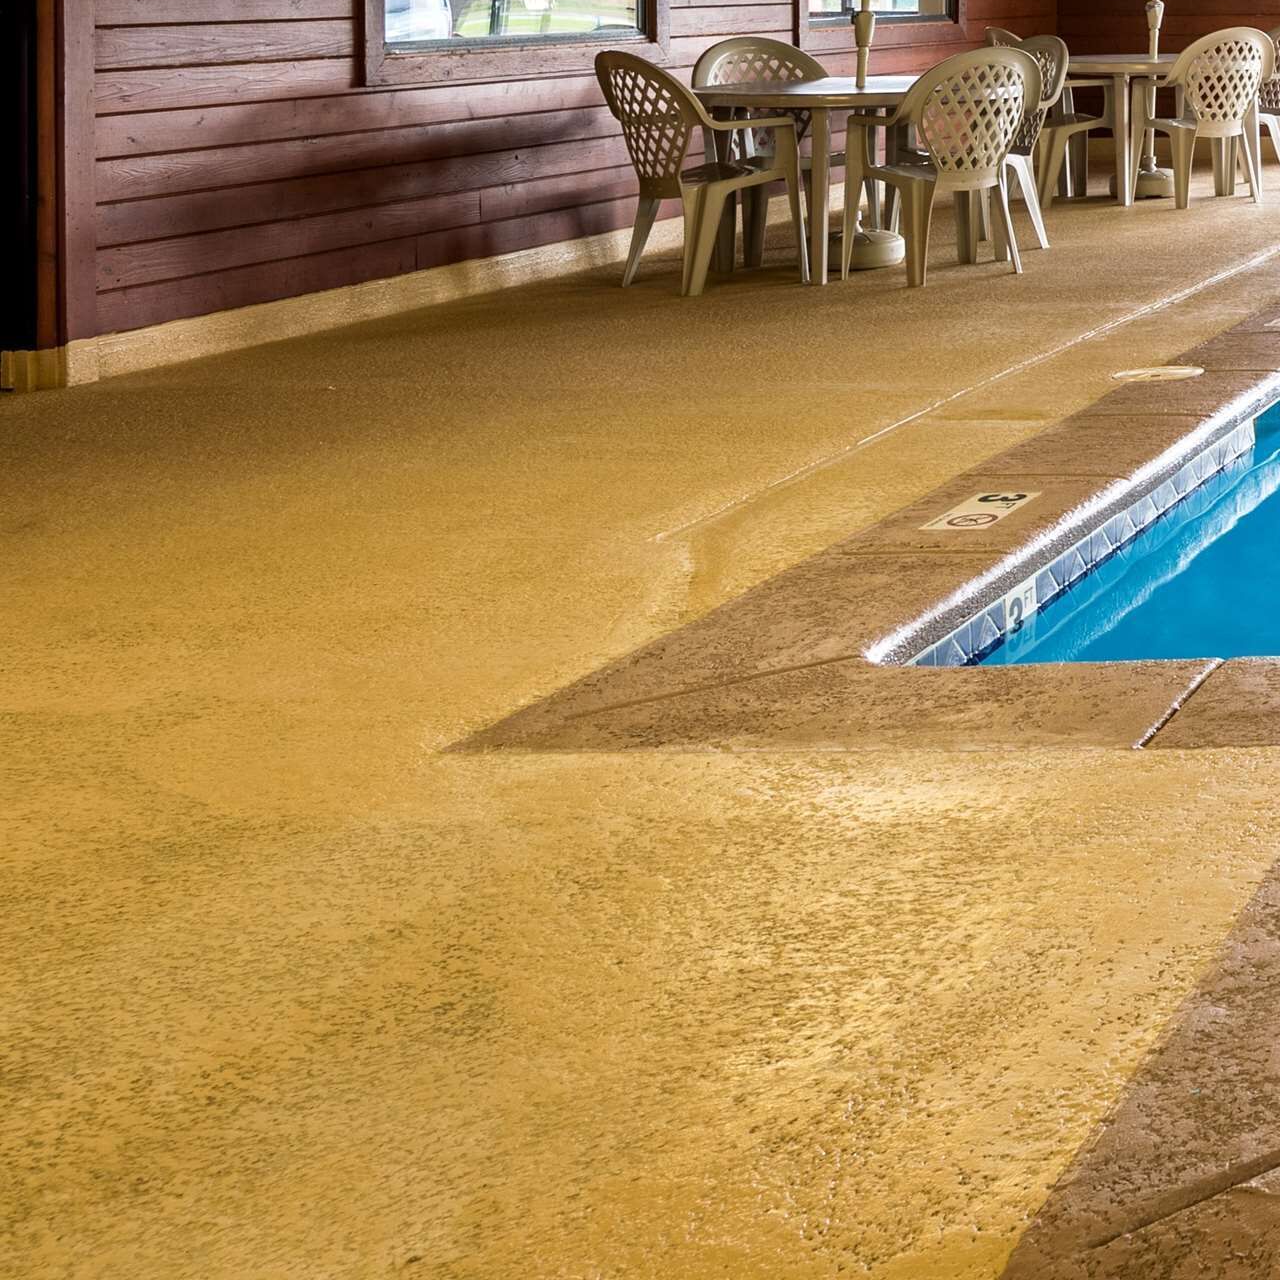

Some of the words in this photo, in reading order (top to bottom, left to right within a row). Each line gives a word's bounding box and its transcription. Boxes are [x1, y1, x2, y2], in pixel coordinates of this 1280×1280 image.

[978, 493, 1028, 503] 3
[1009, 596, 1024, 634] 3
[1024, 586, 1034, 609] FT
